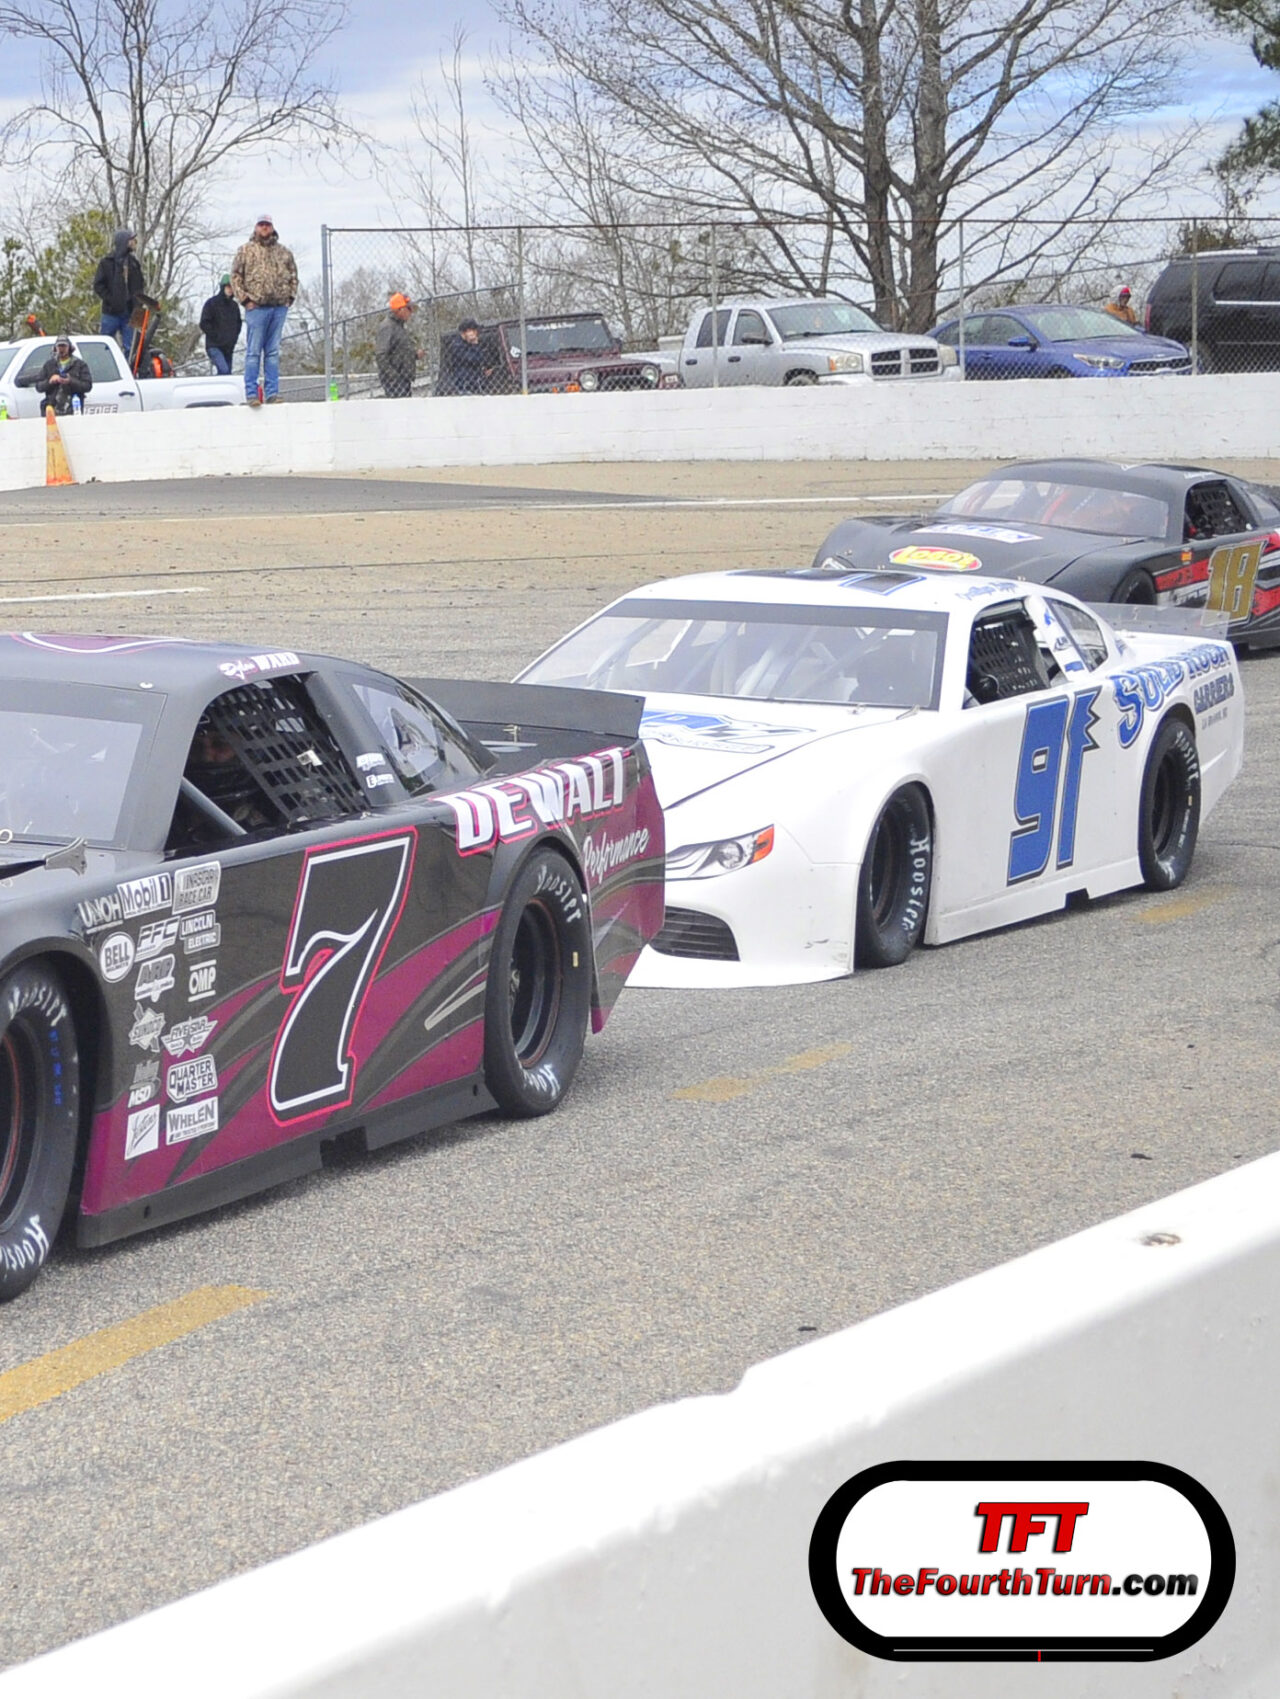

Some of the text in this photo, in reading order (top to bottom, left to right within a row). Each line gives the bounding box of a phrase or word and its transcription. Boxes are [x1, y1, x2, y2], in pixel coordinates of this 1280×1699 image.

[251, 652, 300, 671] WARD
[434, 746, 625, 851] DEWALT
[583, 827, 649, 884] Performance
[119, 878, 158, 912] Mobil
[159, 875, 171, 902] 1
[181, 914, 213, 936] LINCOLN
[187, 931, 217, 949] ELECTRIC
[105, 941, 130, 968] BELL
[189, 966, 216, 994] OMP
[269, 833, 415, 1125] 7
[169, 1060, 212, 1089] QUARTER
[176, 1074, 214, 1096] MASTER
[168, 1103, 215, 1132] WHELEN
